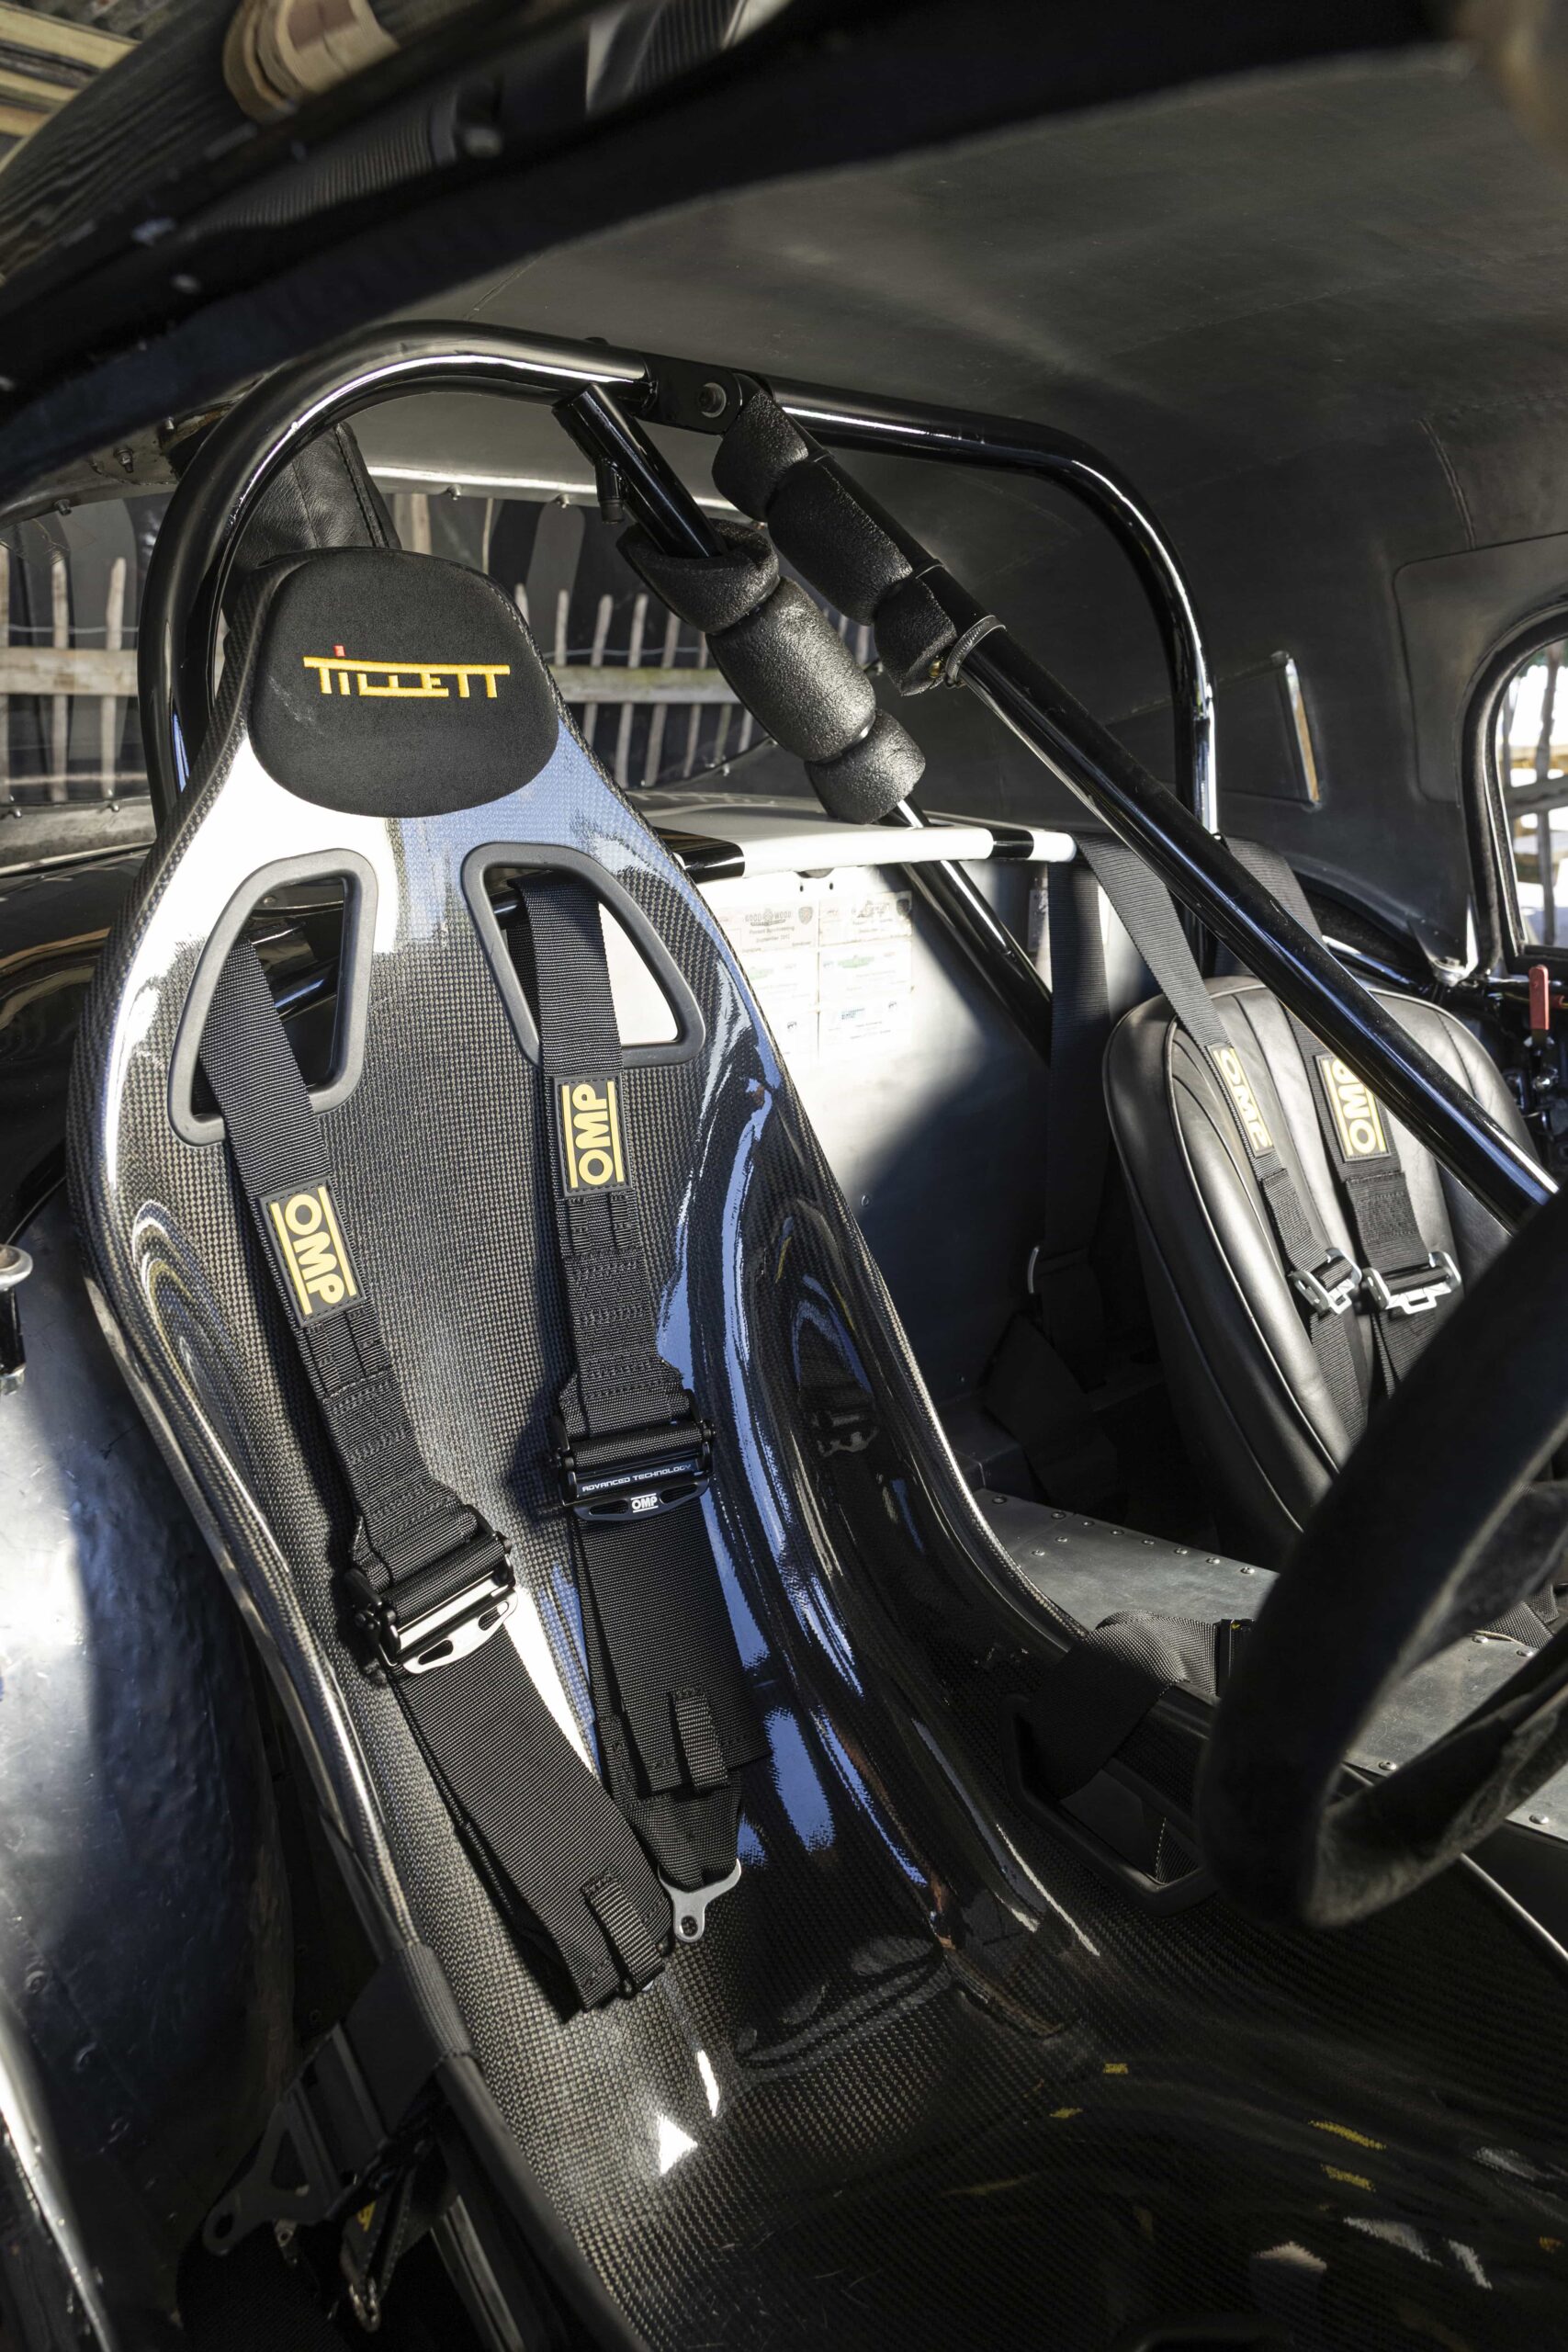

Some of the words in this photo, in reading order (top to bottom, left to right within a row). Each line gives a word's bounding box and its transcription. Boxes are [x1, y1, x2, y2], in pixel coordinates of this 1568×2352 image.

[571, 1082, 615, 1185] OMP
[1220, 1049, 1269, 1148] OMP
[285, 1193, 345, 1305] OMP
[581, 1476, 631, 1492] ADVANCED
[632, 1464, 692, 1481] TECHNOLOGY
[631, 1495, 659, 1510] OMP
